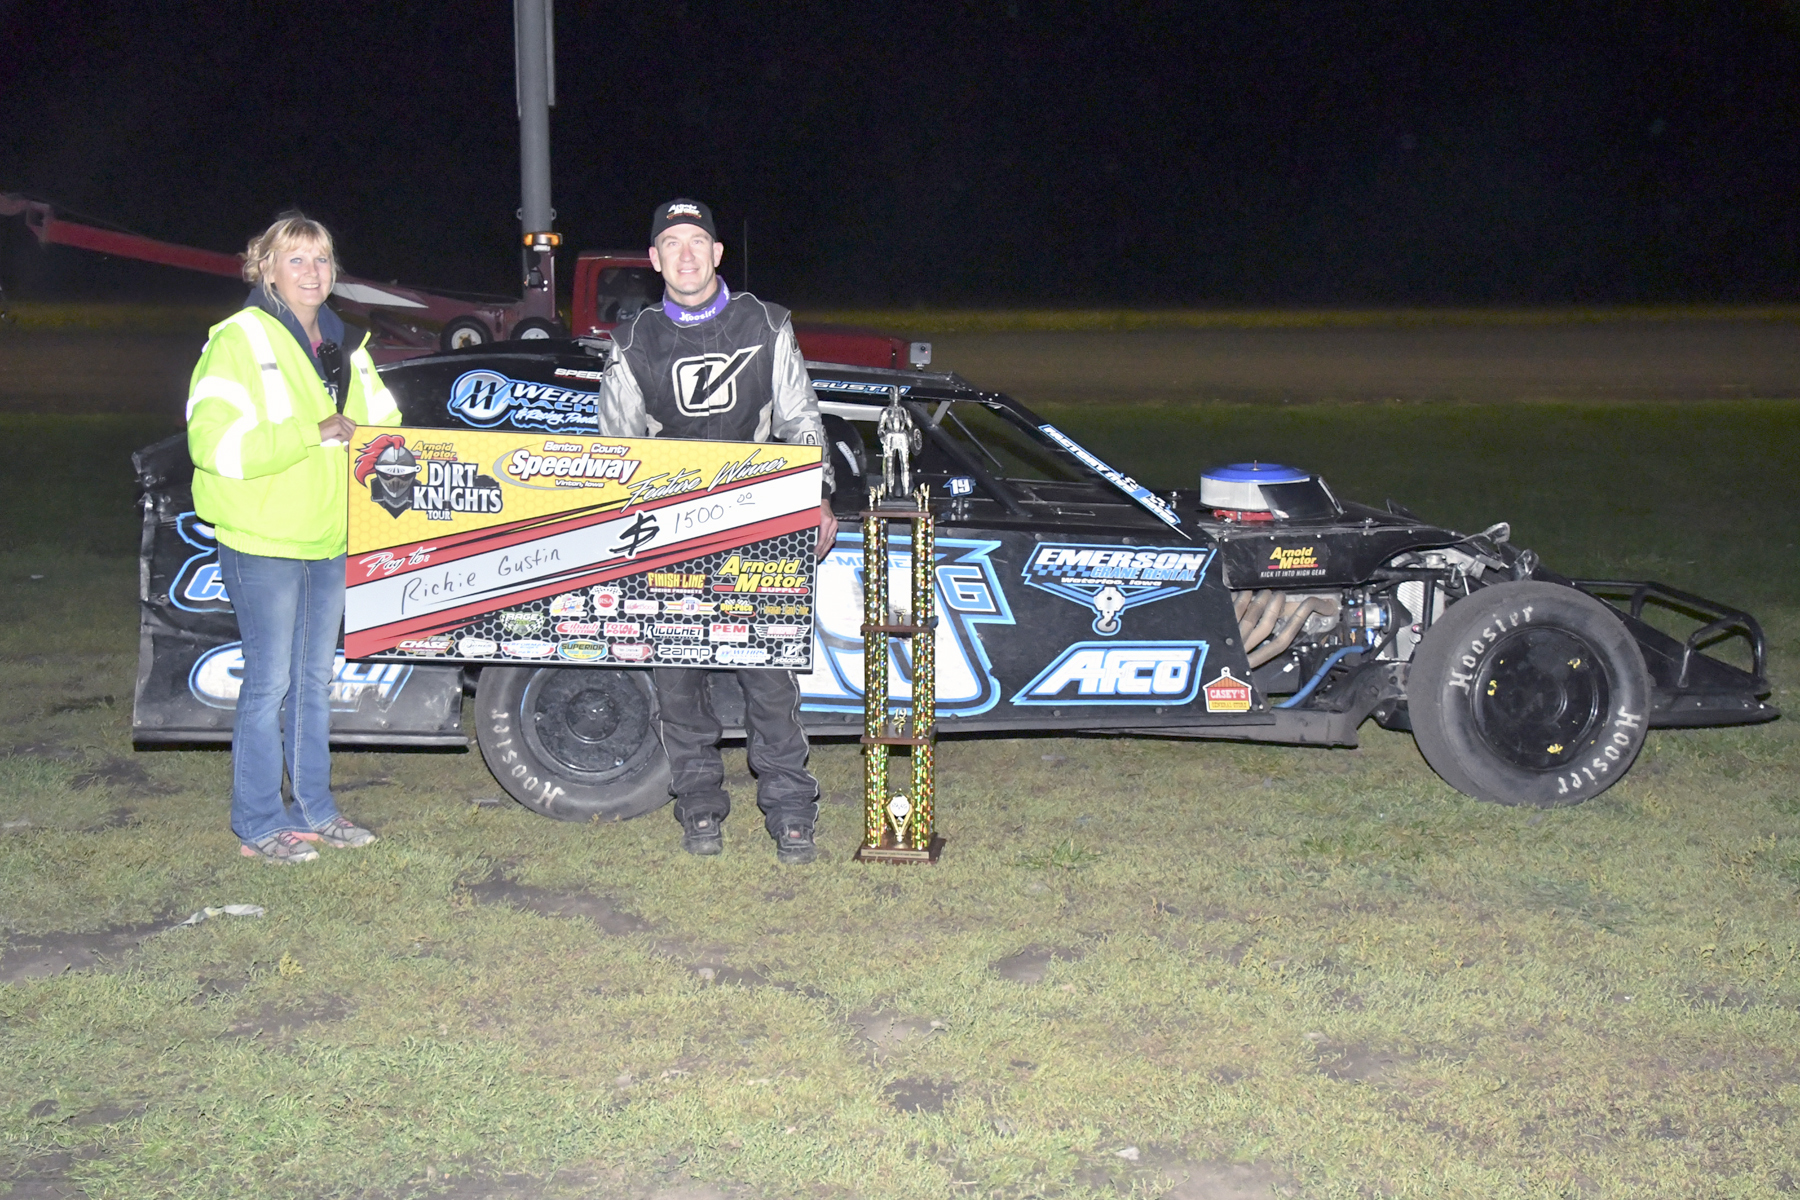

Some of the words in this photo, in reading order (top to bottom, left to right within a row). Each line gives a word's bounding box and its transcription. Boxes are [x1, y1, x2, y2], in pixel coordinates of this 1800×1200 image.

[411, 441, 453, 452] Arnold
[543, 441, 583, 452] Benton
[590, 443, 629, 456] County
[420, 450, 456, 460] Motor
[508, 449, 640, 484] Speedway
[620, 468, 702, 513] Feature
[707, 448, 787, 492] Winner
[951, 478, 971, 495] 19
[428, 510, 451, 520] TOUR
[1035, 548, 1206, 571] EMERSON
[1269, 546, 1314, 560] Arnold
[359, 551, 406, 577] Pay
[718, 555, 800, 576] Arnold
[1278, 557, 1317, 569] Motor
[401, 571, 476, 615] Richie
[497, 548, 561, 576] Gustin
[647, 572, 681, 588] FINISH
[682, 574, 706, 589] LINE
[1061, 577, 1124, 586] Waterloo,
[1090, 566, 1140, 579] CRANE
[1140, 568, 1196, 582] RENTAL
[734, 573, 806, 593] Motor
[556, 622, 599, 632] Eibach
[645, 624, 703, 638] RICOCHET
[712, 624, 746, 633] PEM
[399, 640, 450, 649] CHASE
[1449, 605, 1534, 695] Hoosier
[660, 646, 710, 659] zamp
[1033, 649, 1193, 695] AFCO
[1210, 689, 1246, 699] CASEY'S
[1558, 705, 1642, 795] Hoosier
